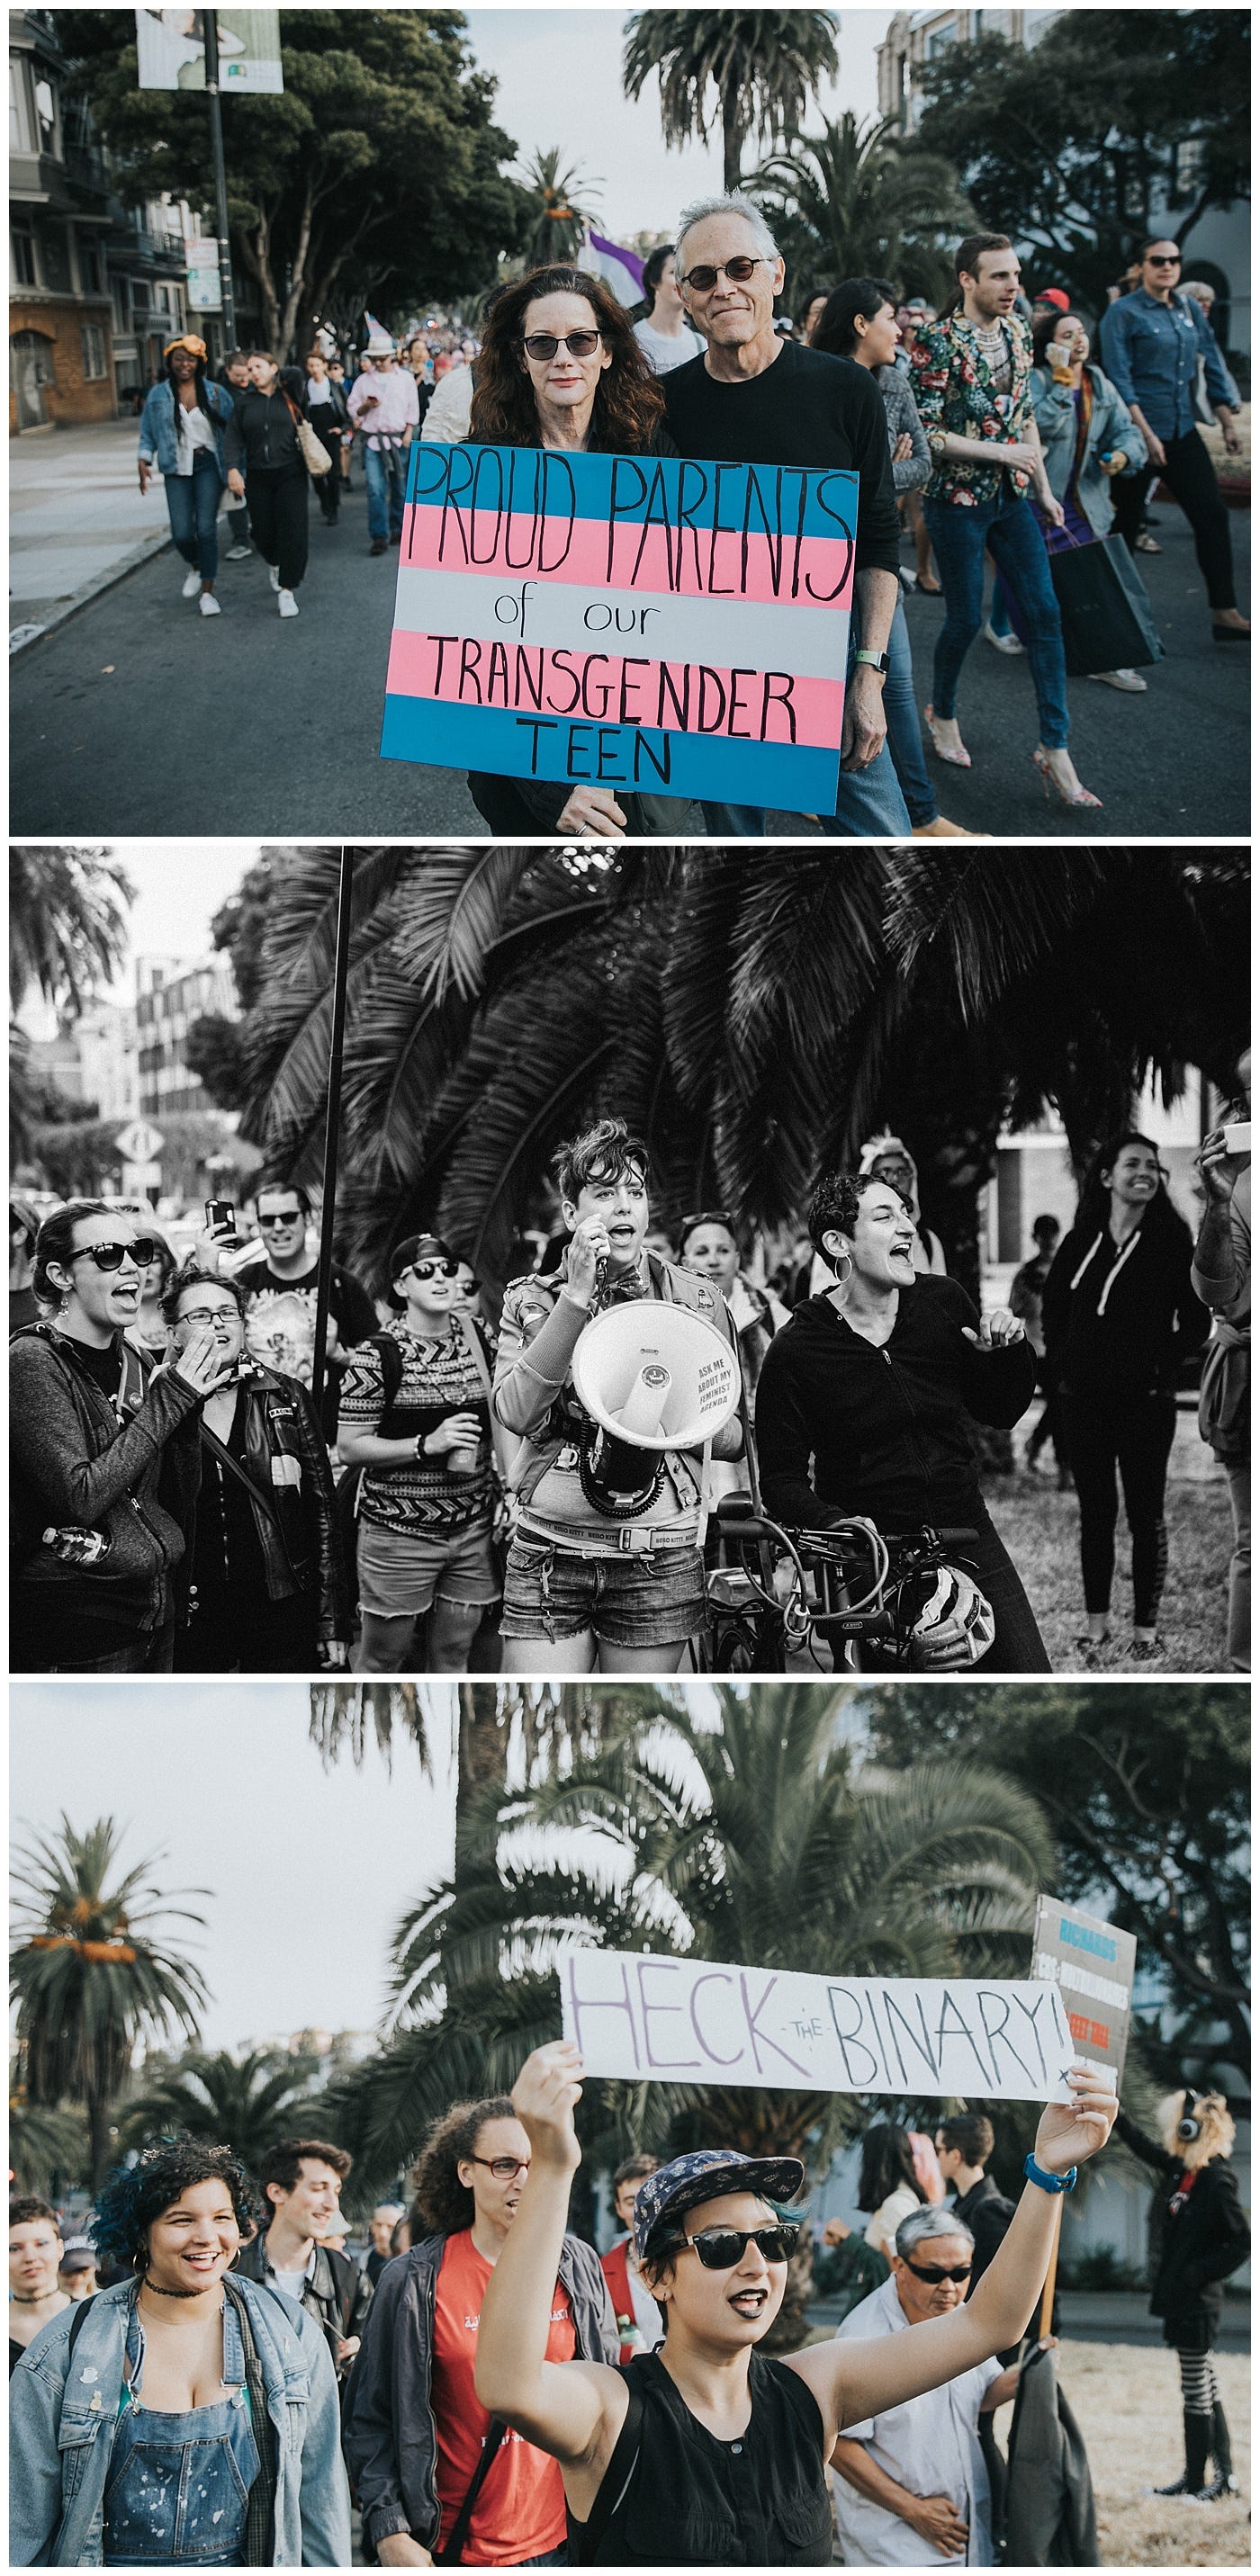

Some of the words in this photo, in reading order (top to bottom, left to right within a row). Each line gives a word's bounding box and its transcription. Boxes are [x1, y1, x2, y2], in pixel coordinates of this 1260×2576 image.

[410, 447, 576, 572] PROUD
[607, 458, 859, 601] PARENTS
[494, 581, 537, 638] of
[583, 603, 661, 635] our
[428, 636, 796, 744] TRANSGENDER
[516, 718, 670, 785] TEEN
[698, 1364, 713, 1378] ASK
[713, 1359, 724, 1370] ME
[698, 1375, 718, 1394] ABOUT
[720, 1369, 731, 1381] MY
[699, 1383, 730, 1405] FEMINIST
[699, 1396, 727, 1414] AGENDA
[569, 1955, 812, 2078] HECK
[788, 2017, 824, 2041] THE
[827, 1985, 1070, 2089] BINARY!
